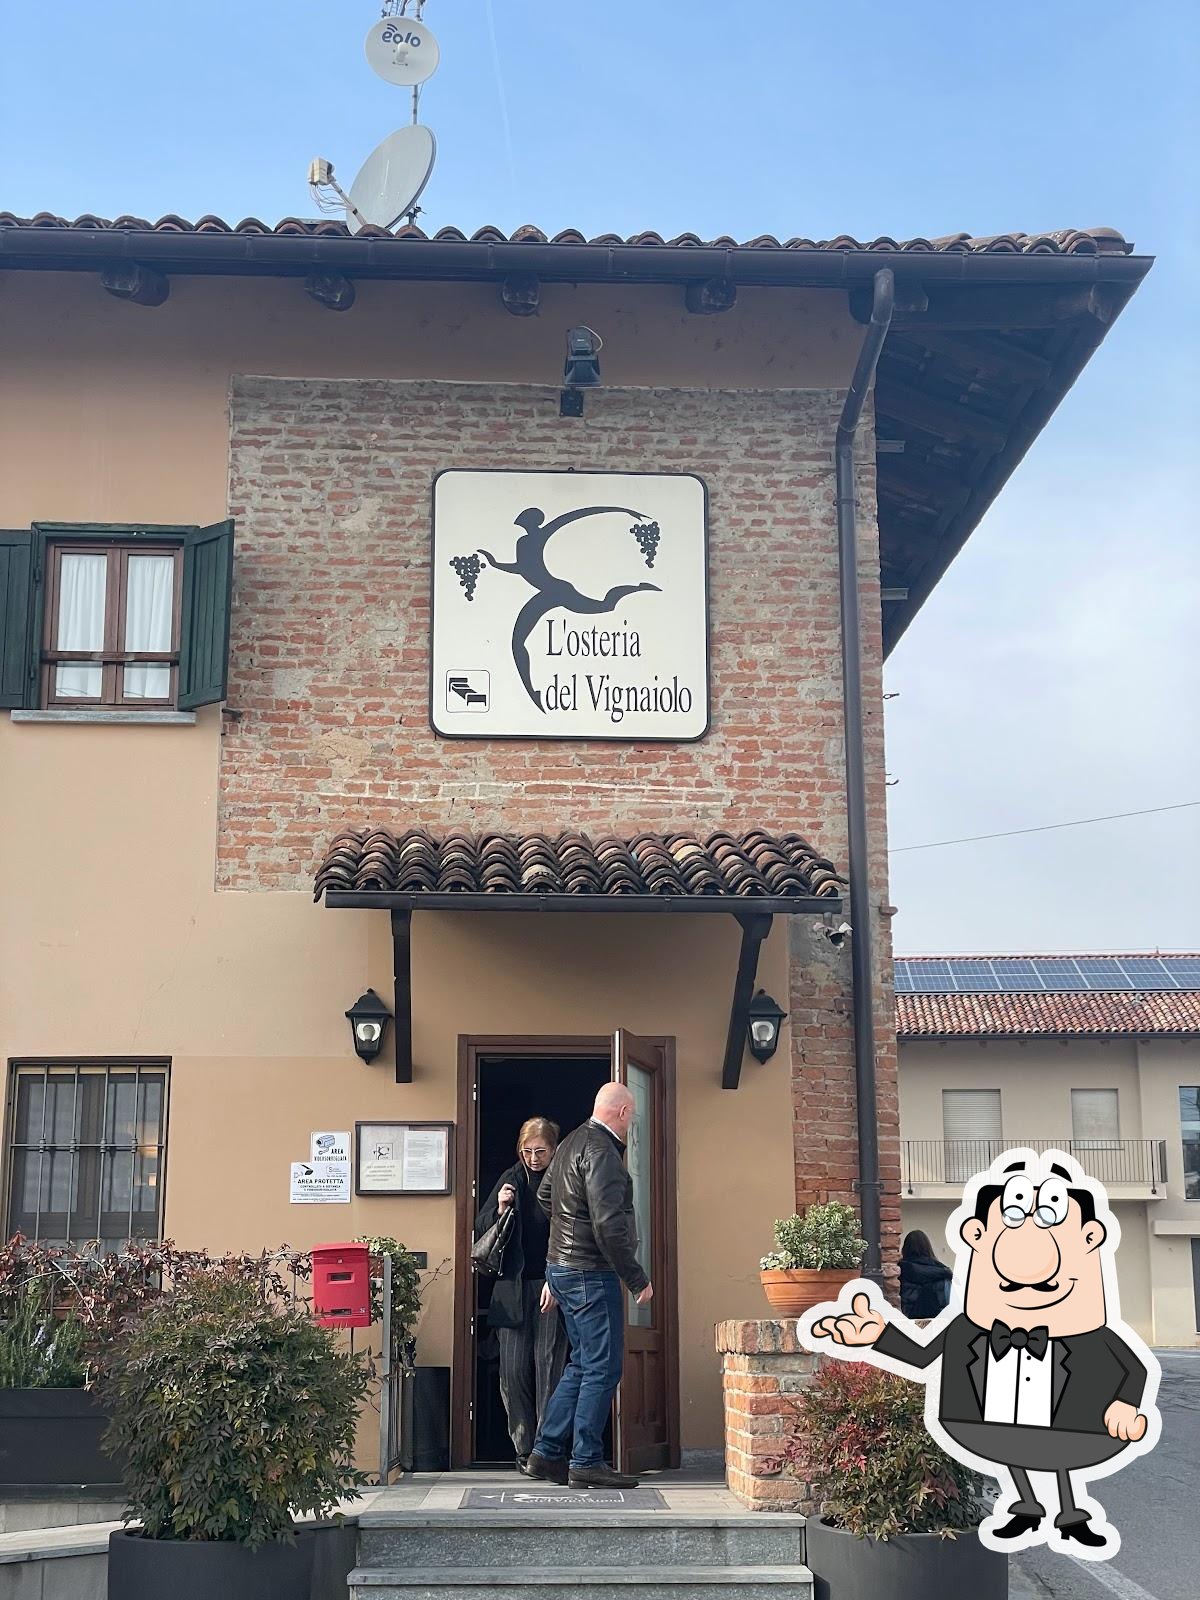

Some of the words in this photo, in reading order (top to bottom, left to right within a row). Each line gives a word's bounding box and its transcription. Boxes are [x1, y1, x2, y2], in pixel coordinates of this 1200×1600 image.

[382, 31, 421, 47] eolo
[546, 619, 642, 657] L'osteria
[545, 674, 578, 711] del
[585, 675, 692, 723] Vignaiolo
